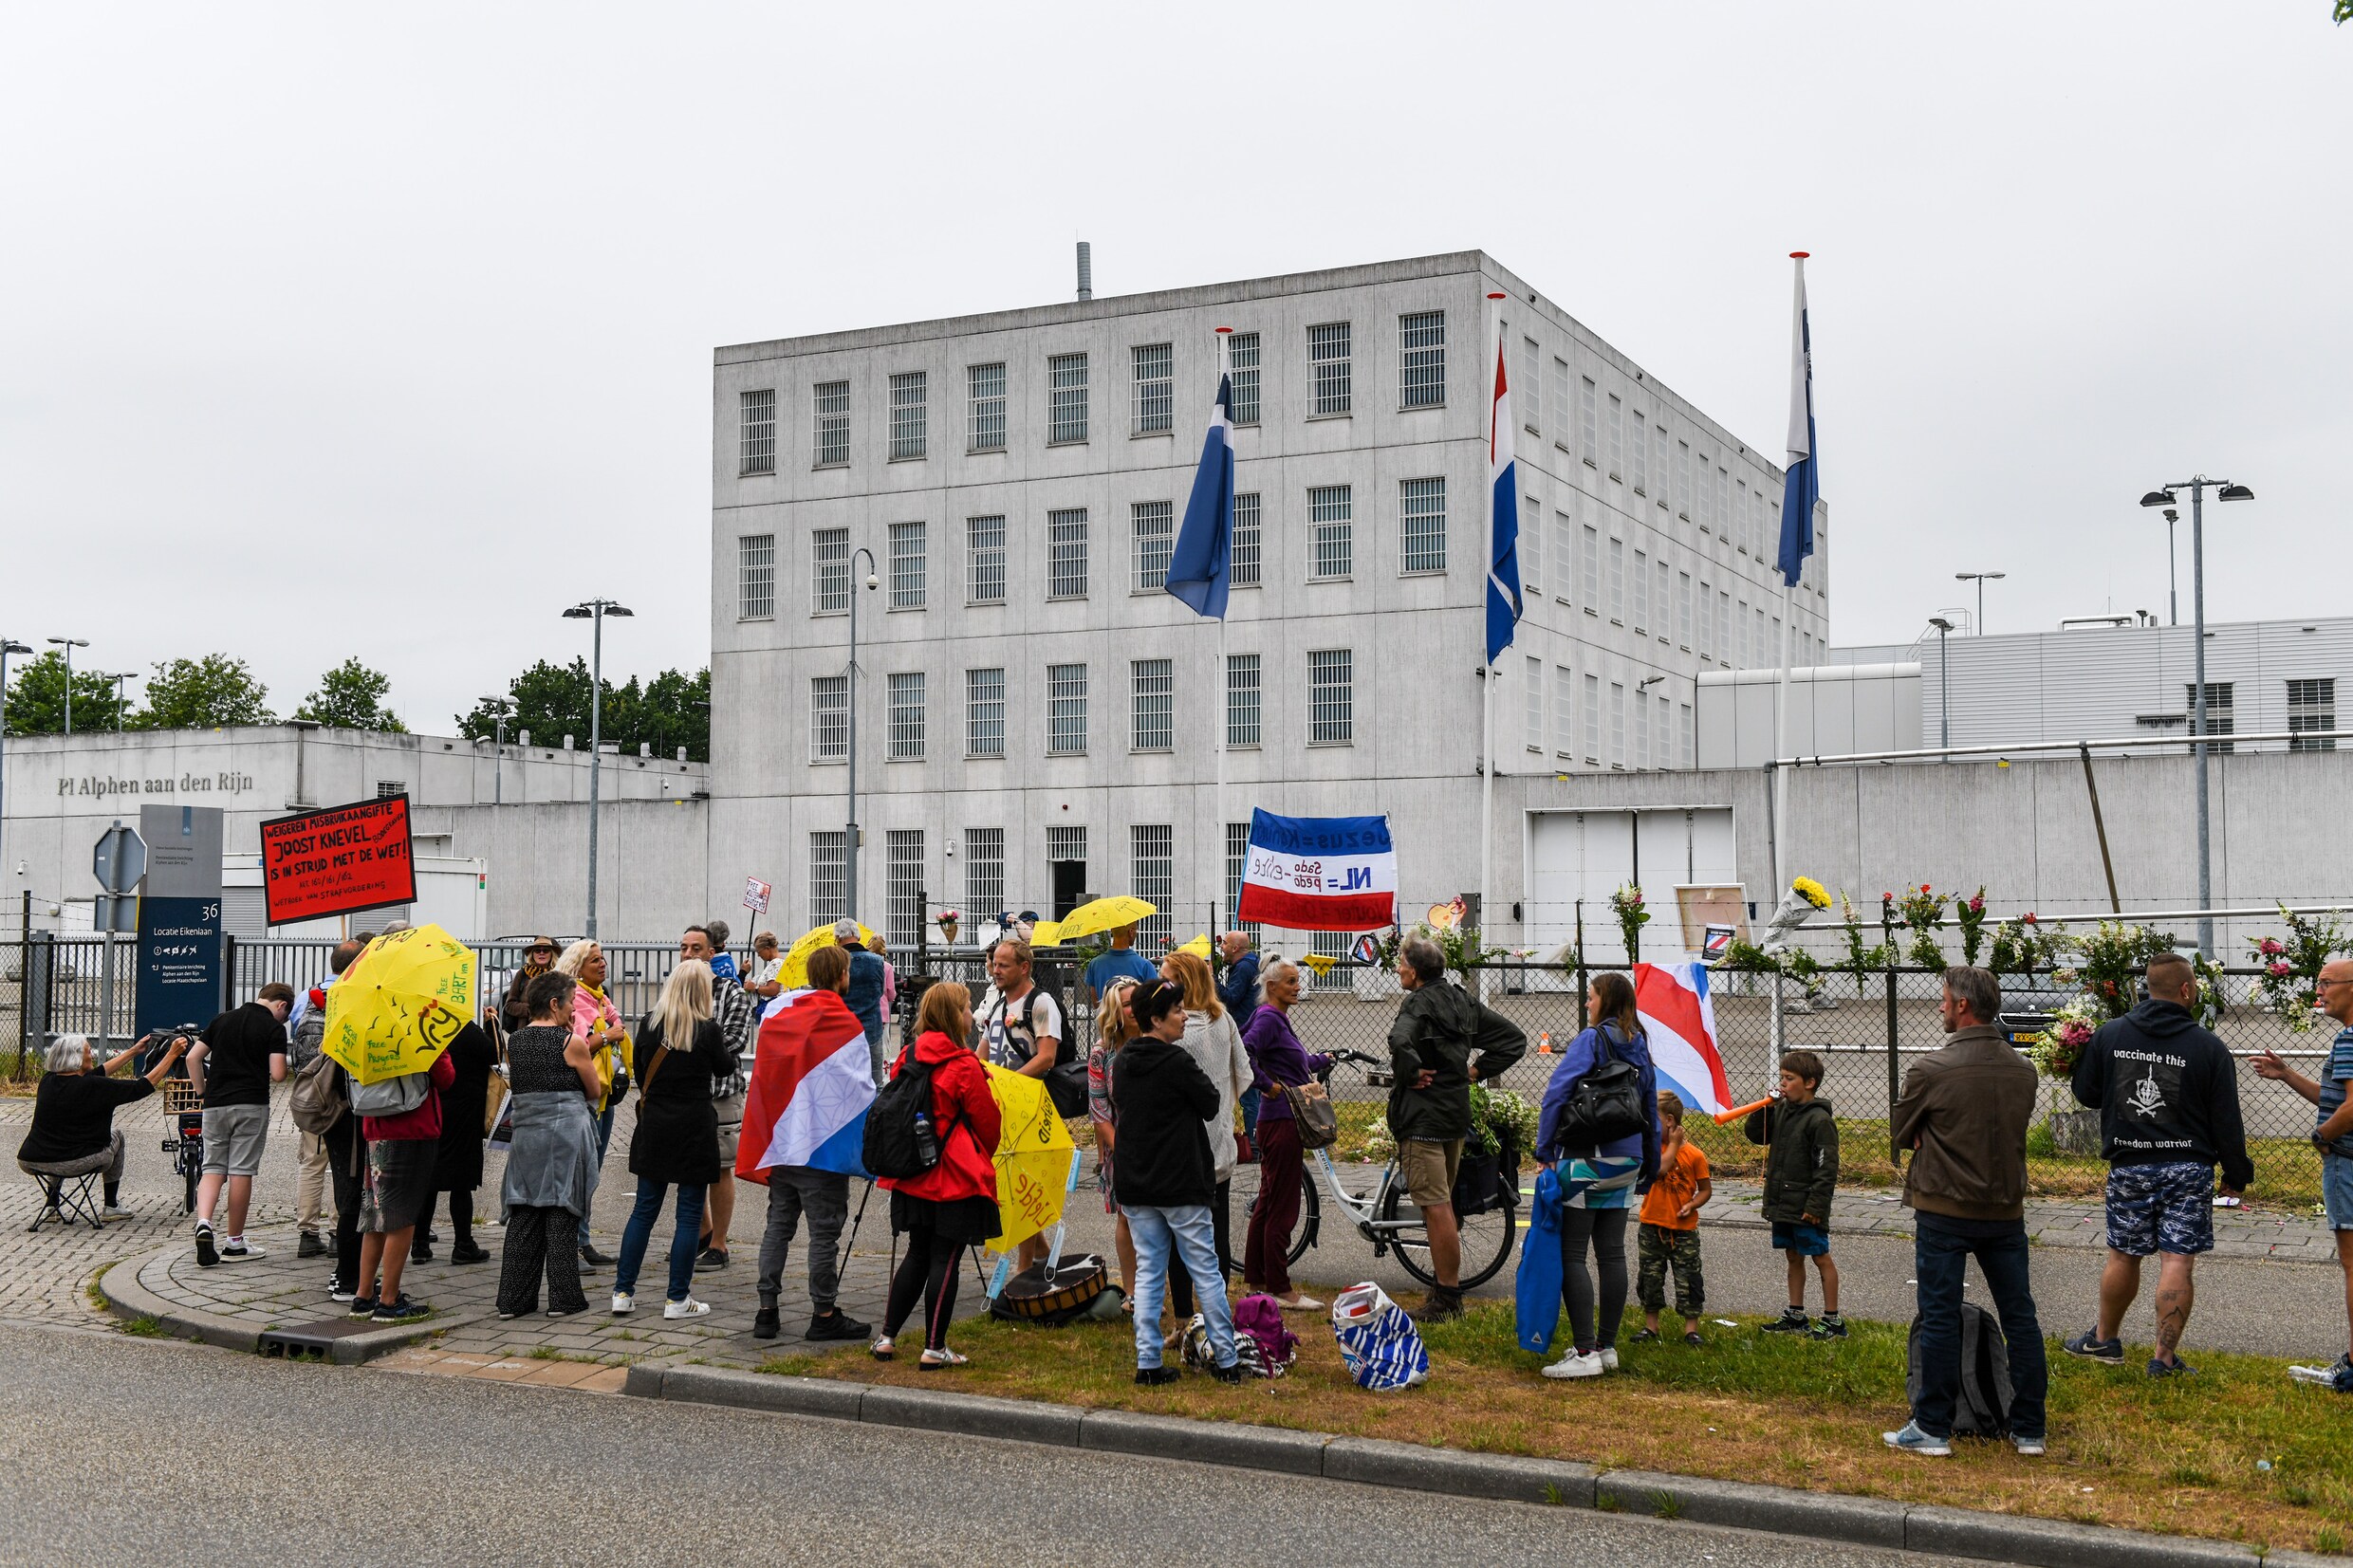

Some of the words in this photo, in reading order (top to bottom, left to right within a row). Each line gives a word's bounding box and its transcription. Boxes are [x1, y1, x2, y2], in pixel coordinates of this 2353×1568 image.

[58, 777, 74, 796] PI
[79, 776, 139, 800] Alphen
[144, 778, 175, 793] aan
[180, 773, 211, 792] den
[217, 772, 252, 795] Rijn
[266, 821, 306, 839] WEIGEREN
[309, 802, 393, 830] MISBRUIKAANGIFTE
[273, 836, 316, 862] JOOST
[320, 824, 371, 850] KNEVEL
[271, 869, 279, 881] IS
[283, 865, 291, 877] IN
[295, 858, 328, 876] STRIJD
[333, 851, 356, 868] MET
[360, 848, 373, 862] DE
[274, 896, 303, 908] WETBOEK
[321, 881, 386, 900] STRAFVORDERING
[202, 903, 218, 921] 36
[154, 928, 178, 936] Locatie
[180, 927, 213, 936] Eikenlaan
[1055, 923, 1084, 939] LIEFDE
[451, 971, 467, 1004] BART
[2114, 1049, 2162, 1062] vaccinate
[2165, 1054, 2187, 1067] this
[2155, 1139, 2193, 1148] warrior
[1317, 1149, 1330, 1171] azelle
